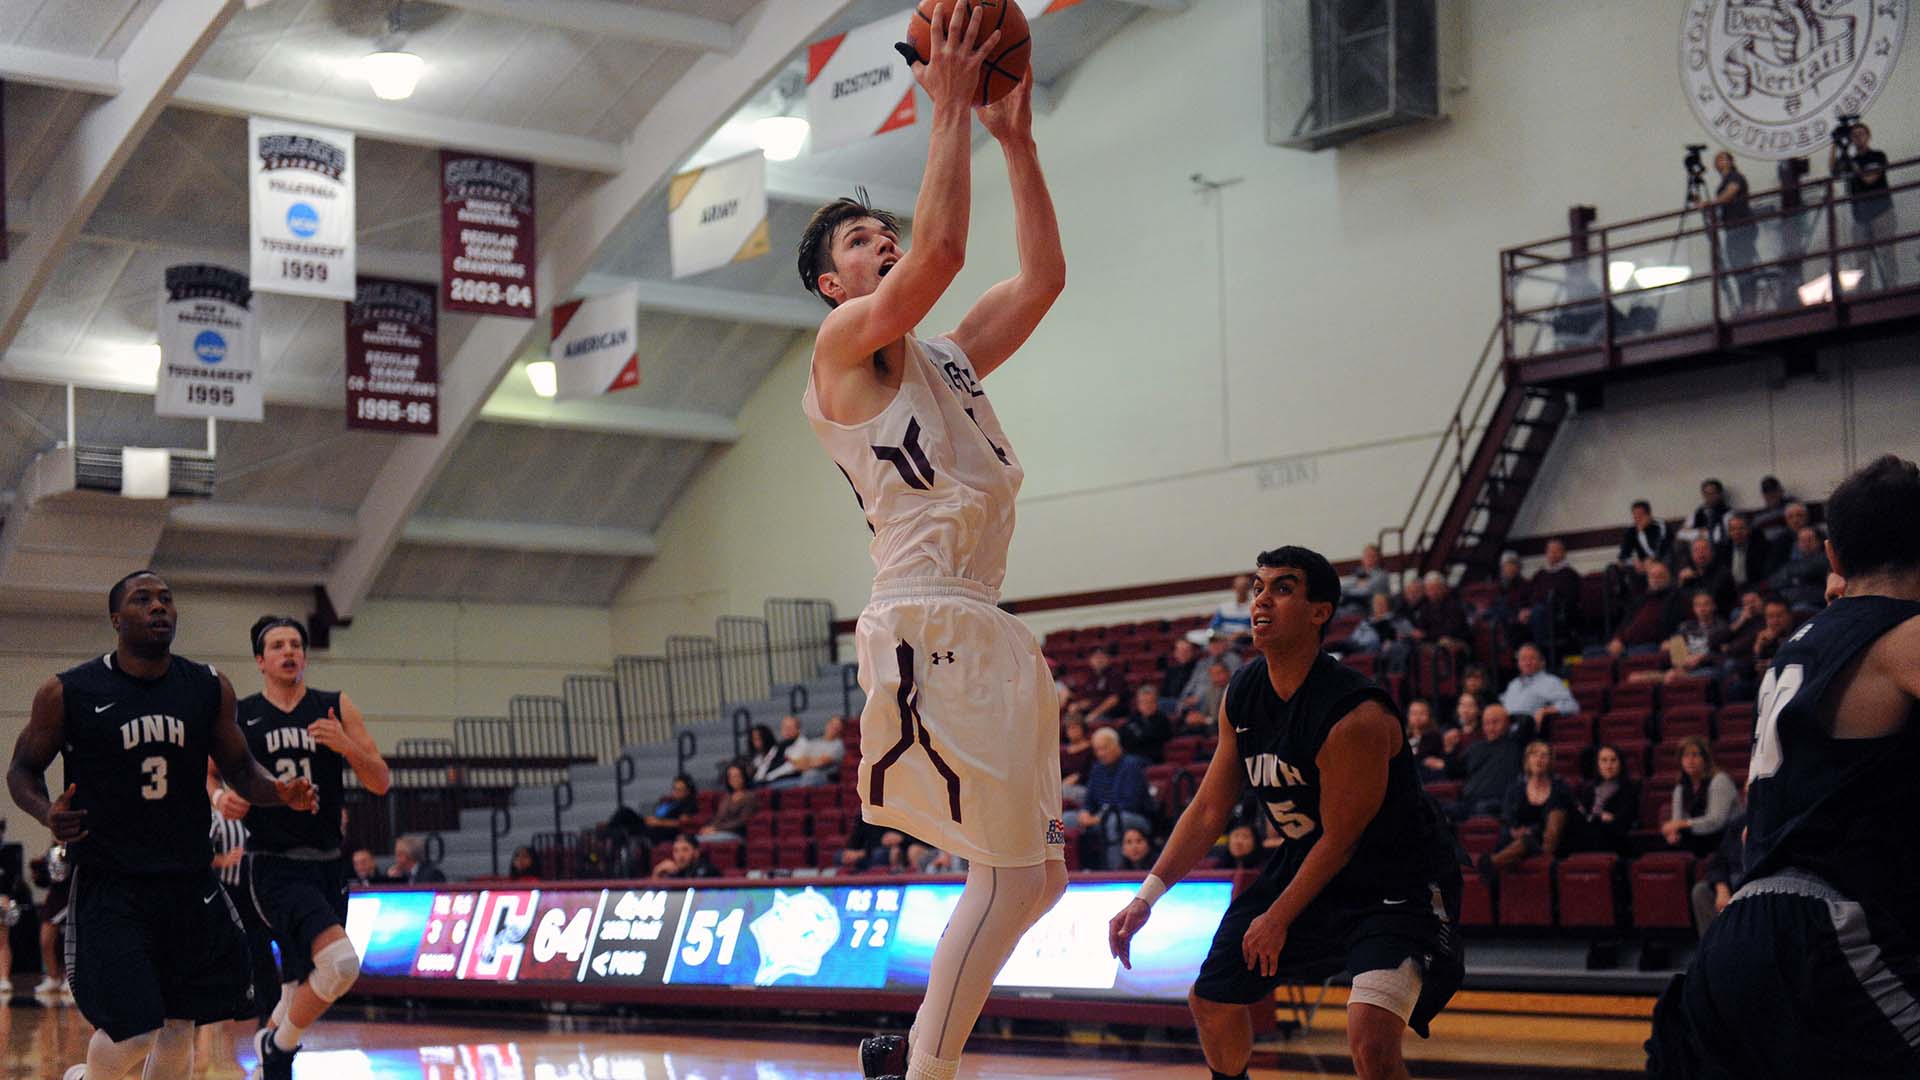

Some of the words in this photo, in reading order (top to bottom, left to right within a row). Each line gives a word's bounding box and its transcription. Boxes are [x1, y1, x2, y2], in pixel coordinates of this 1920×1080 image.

[833, 66, 893, 98] BOSTON
[1714, 111, 1829, 152] FOUNDED
[700, 200, 739, 224] ARMY
[261, 238, 344, 258] TOURNAMENT
[460, 229, 518, 248] REGULAR
[282, 260, 328, 282] 1999
[453, 256, 525, 278] CHAMPIONS
[450, 278, 532, 307] 2003-04
[564, 331, 627, 357] AMERICAN
[168, 363, 252, 383] TOURNAMENT
[188, 384, 235, 406] 1995
[357, 397, 431, 423] 1995-96
[120, 714, 185, 750] UNH
[265, 727, 318, 753] UNH
[141, 755, 168, 800] 3
[1245, 753, 1309, 787] UNH
[427, 919, 443, 944] 3
[533, 907, 592, 963] 64
[681, 909, 744, 966] 51
[850, 920, 869, 948] 7
[868, 919, 889, 947] 2
